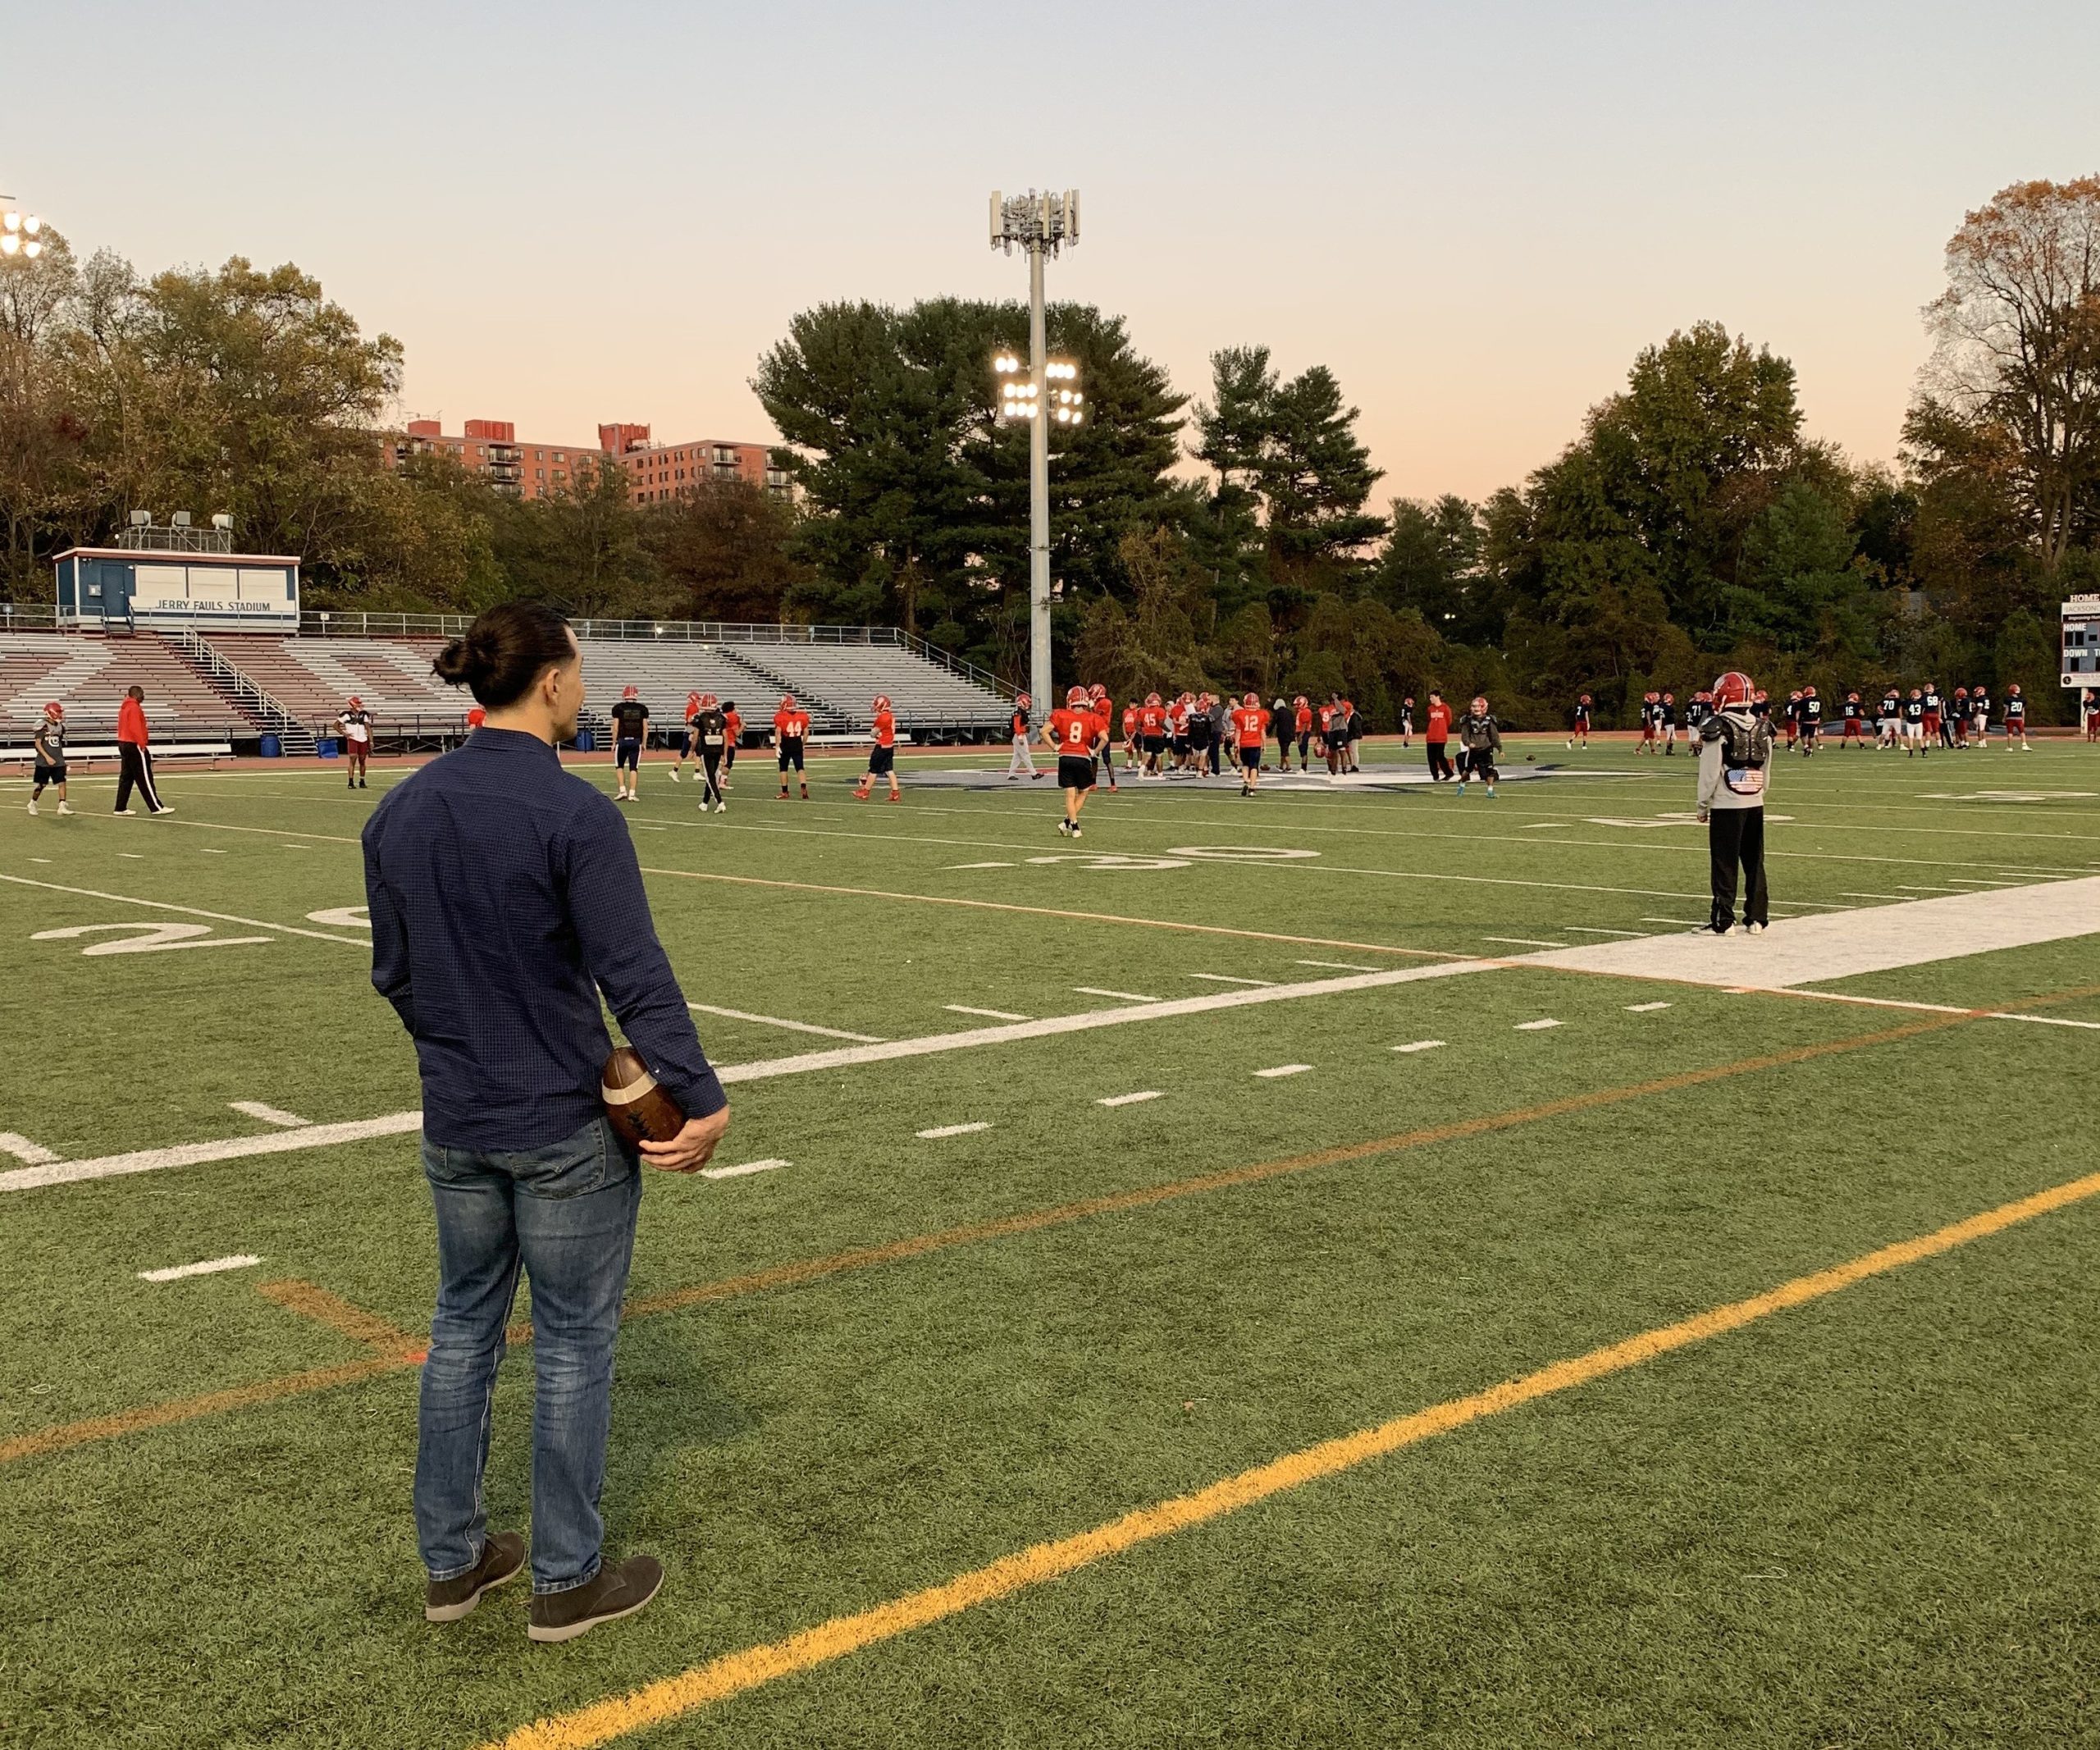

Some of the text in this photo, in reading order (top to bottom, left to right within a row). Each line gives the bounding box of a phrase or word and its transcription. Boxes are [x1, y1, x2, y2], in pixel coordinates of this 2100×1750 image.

[2070, 594, 2100, 602] HOME
[155, 600, 270, 612] JERRY FAULS STADIUM
[2063, 623, 2087, 632] HOME
[2063, 649, 2088, 657] DOWN
[1691, 705, 1701, 716] 71
[1808, 701, 1820, 713] 50
[1845, 706, 1854, 715] 16
[1883, 700, 1895, 711] 70
[1909, 704, 1921, 715] 43
[2011, 701, 2023, 712] 20
[1144, 713, 1157, 726] 45
[1244, 715, 1258, 732] 12
[786, 721, 801, 737] 44
[1069, 721, 1082, 743] 8
